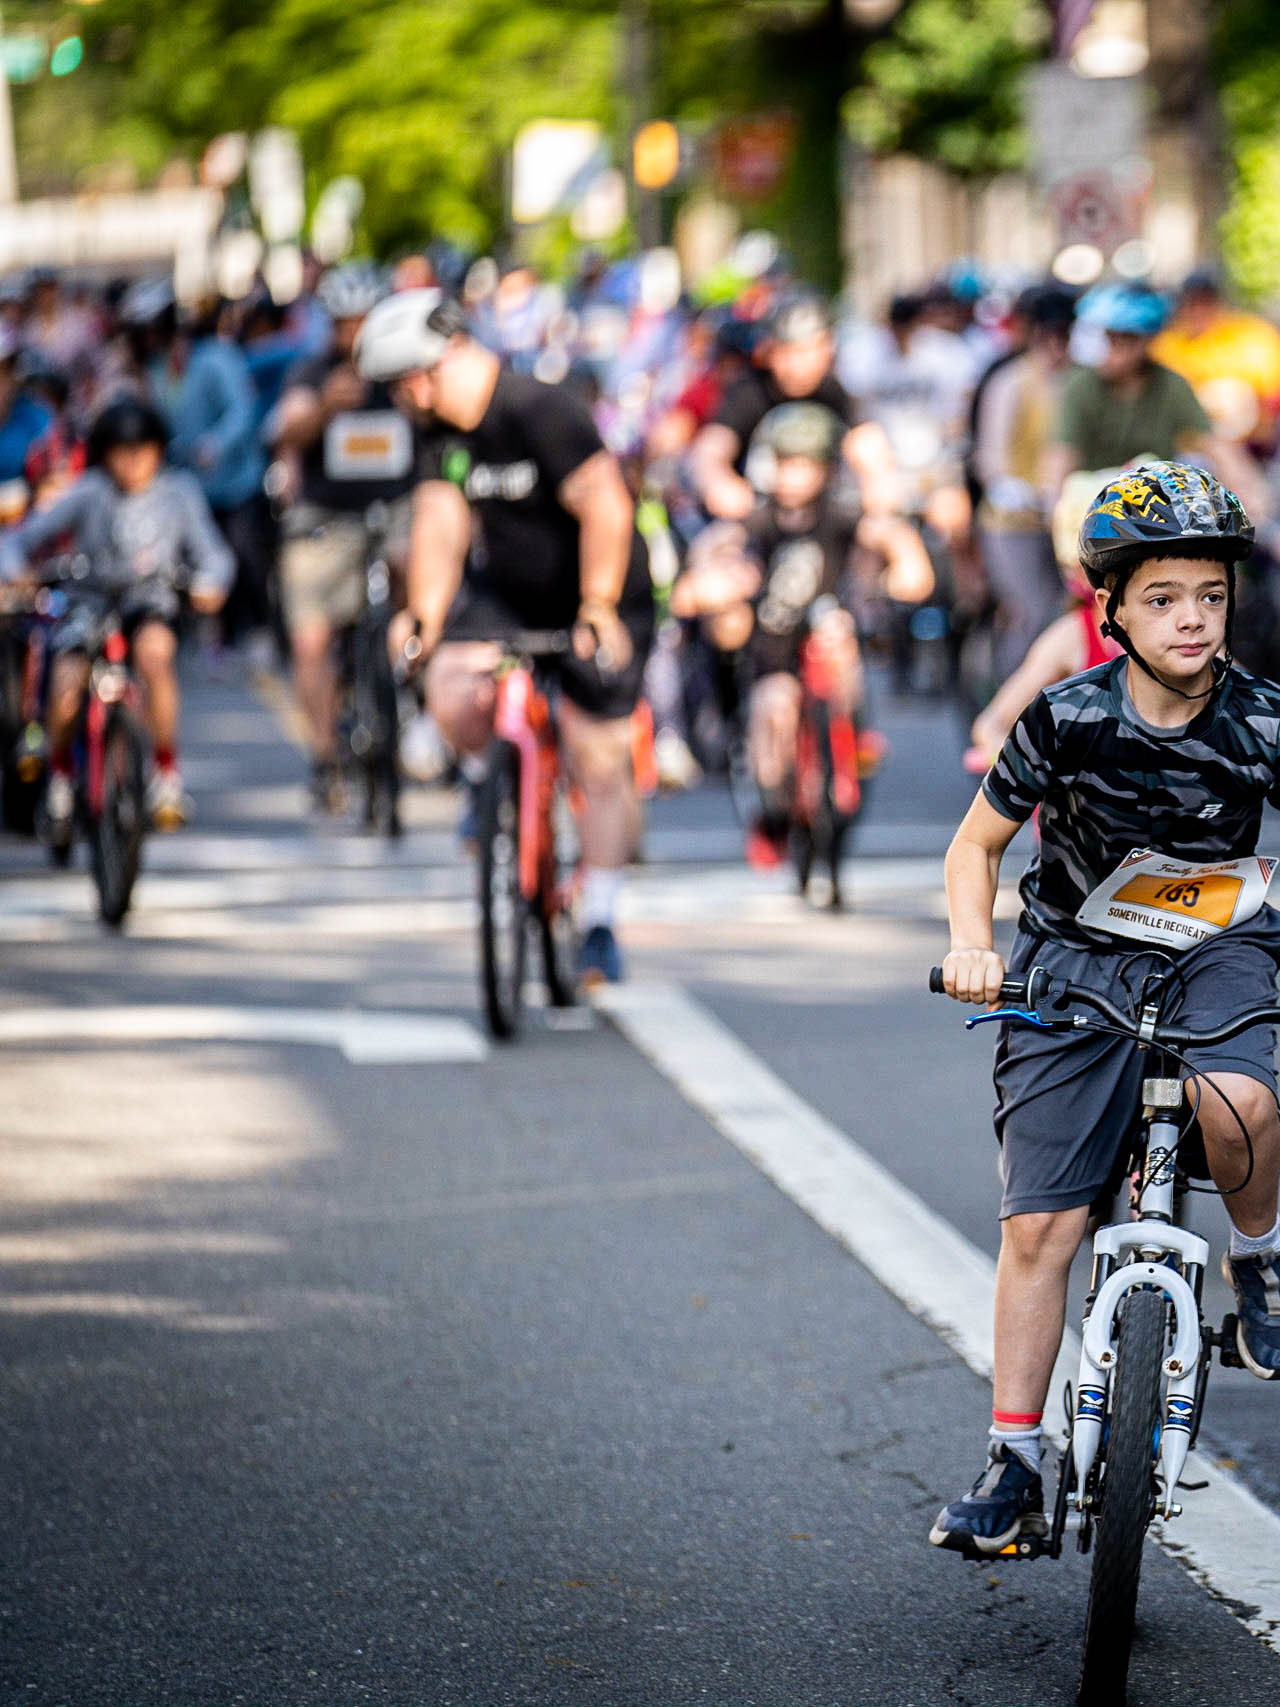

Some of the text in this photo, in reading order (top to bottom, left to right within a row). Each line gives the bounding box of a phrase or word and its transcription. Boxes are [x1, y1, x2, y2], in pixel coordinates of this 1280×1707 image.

[1154, 881, 1205, 907] 165
[1107, 907, 1214, 941] SOMERVILLE RECREATI
